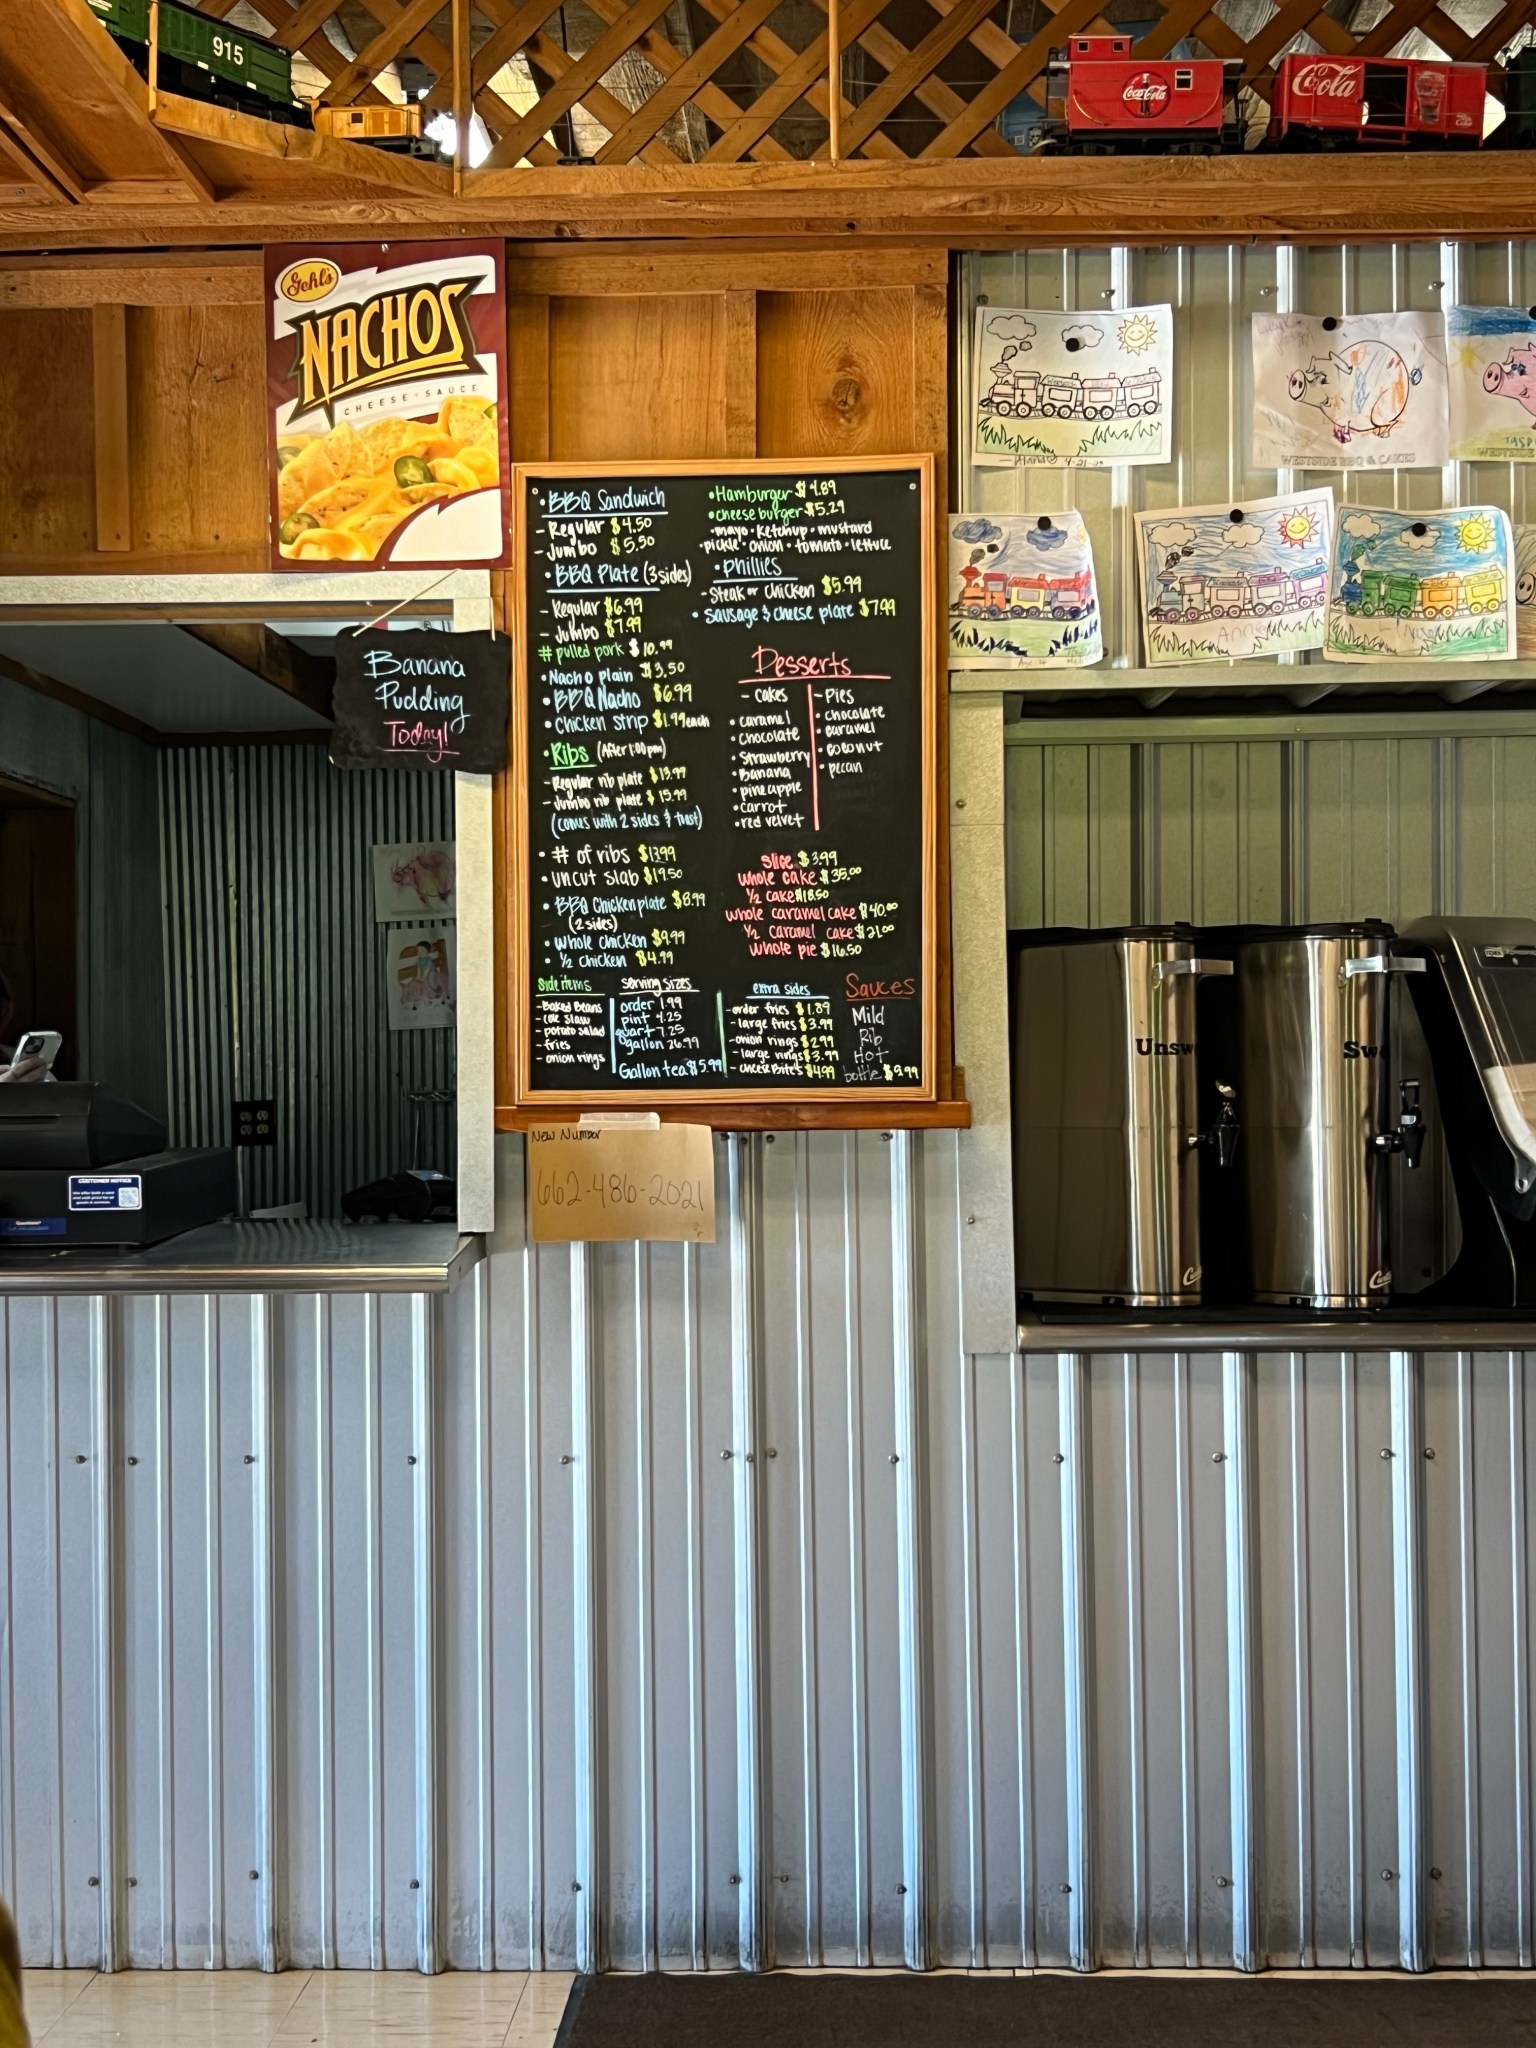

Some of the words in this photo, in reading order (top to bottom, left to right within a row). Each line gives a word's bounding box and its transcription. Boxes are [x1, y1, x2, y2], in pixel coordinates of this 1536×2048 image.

[213, 35, 244, 65] 915
[286, 268, 335, 296] Gehl's
[300, 283, 470, 408] NACHOS
[344, 393, 408, 416] CHEESE
[426, 384, 478, 397] SAUCE
[549, 490, 591, 513] BBQ
[598, 486, 666, 511] Sandwich
[715, 485, 793, 509] Hamburger
[549, 519, 605, 545] Regular
[714, 526, 748, 541] mayo
[818, 521, 872, 534] mustard
[547, 540, 597, 561] Jumbo
[704, 538, 738, 554] pickle
[795, 539, 842, 553] tomato
[851, 538, 891, 551] lettuce
[556, 563, 593, 587] BBQ
[821, 575, 862, 596] $5.99
[552, 599, 600, 626] Regular
[604, 597, 642, 618] $6.99
[819, 604, 854, 624] plate
[555, 622, 599, 643] Jumbo
[604, 617, 642, 638] $7.99
[556, 644, 590, 665] pulled
[594, 642, 624, 662] pork
[752, 645, 851, 677] Desserts
[364, 650, 466, 678] Banana
[550, 669, 593, 685] Nacho
[599, 669, 633, 684] plain
[639, 662, 685, 679] $3.50
[375, 681, 471, 734] Pudding
[554, 686, 596, 713] BBQ
[598, 686, 641, 711] Nacho
[653, 683, 692, 702] $6.99
[740, 710, 790, 727] caramel
[383, 721, 448, 763] Today!
[550, 742, 589, 766] Ribs
[829, 762, 862, 779] pecan
[618, 771, 643, 791] plate
[616, 793, 643, 811] plate
[593, 813, 617, 829] with
[620, 814, 629, 828] 2
[631, 814, 659, 827] sides
[741, 816, 761, 829] red
[765, 814, 805, 827] velvet
[577, 844, 592, 864] of
[597, 844, 630, 864] ribs
[797, 851, 838, 867] $3.99
[644, 866, 682, 885] $19.50
[672, 890, 705, 909] $8.99
[651, 929, 685, 947] $9.99
[635, 950, 673, 967] $4.99
[798, 943, 818, 959] pie
[820, 942, 862, 958] $16.50
[784, 982, 810, 996] sides
[846, 973, 915, 997] Sauces
[620, 997, 655, 1013] order
[660, 996, 683, 1010] 1.99
[621, 1012, 650, 1030] pint
[656, 1011, 682, 1023] 4.25
[852, 1005, 884, 1026] Mild
[579, 1025, 605, 1037] salad
[615, 1024, 655, 1044] quart
[738, 1019, 768, 1034] large
[625, 1038, 664, 1055] gallon
[860, 1028, 882, 1046] Rib
[1135, 1037, 1199, 1056] Unsw
[578, 1053, 605, 1070] rings
[741, 1049, 770, 1063] large
[854, 1047, 889, 1064] Hot
[619, 1063, 661, 1079] Gallon
[532, 1130, 555, 1142] New
[538, 1168, 704, 1211] 662-486-2021
